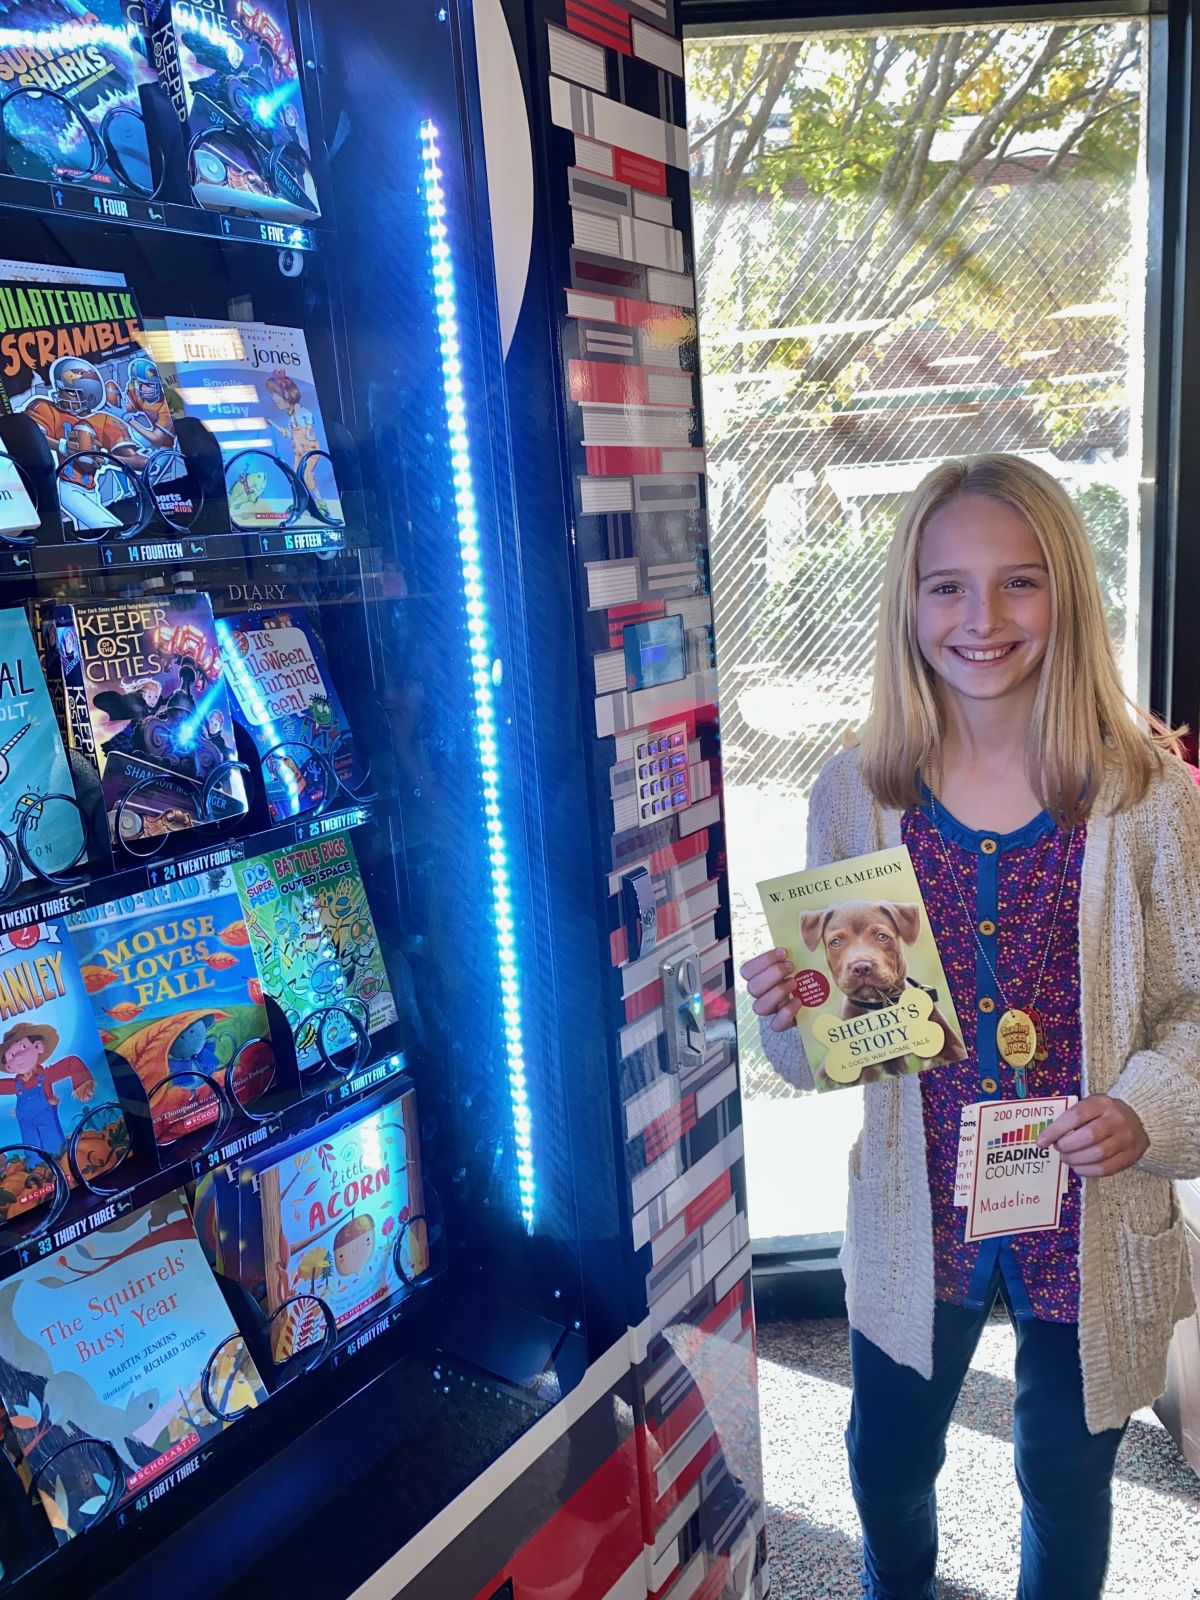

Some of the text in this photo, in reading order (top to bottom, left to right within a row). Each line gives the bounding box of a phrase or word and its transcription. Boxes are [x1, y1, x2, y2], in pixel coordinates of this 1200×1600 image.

[19, 46, 107, 98] SHARKS
[94, 196, 129, 217] 4 FOUR
[260, 225, 286, 243] 5 FIVE
[0, 287, 137, 333] UARTERBACK
[1, 320, 144, 377] SCRAMBLE
[252, 344, 301, 368] jones
[128, 543, 184, 561] 14 FOURTEEN
[284, 533, 323, 549] 15 FIFTEEN
[228, 584, 287, 600] DIARY
[78, 609, 170, 637] KEEPER
[82, 631, 144, 660] LOST
[250, 631, 274, 650] It's
[86, 654, 161, 682] CITIES
[256, 664, 320, 696] Turning
[309, 822, 320, 836] 25
[320, 814, 348, 833] TWENTY
[163, 849, 231, 881] 24 TWENTY FOUR
[242, 862, 269, 887] DC
[273, 838, 347, 879] BATTLE BUGS
[145, 876, 200, 908] READ
[280, 860, 352, 896] OUTER SPACE
[769, 861, 903, 903] W. BRUCE CAMERON
[0, 896, 71, 930] TWENTY THREE
[99, 915, 215, 970] MOUSE
[119, 940, 209, 985] LOVES
[134, 967, 215, 1007] FALL
[848, 1057, 870, 1067] DOG'S
[871, 1053, 886, 1061] WAY
[889, 1045, 911, 1055] HOME
[912, 1038, 930, 1048] TALE
[340, 1064, 387, 1098] 35 THIRTY FIVE
[993, 1106, 1055, 1121] 200 POINTS
[208, 1127, 268, 1168] 34 THIRTY FOUR
[986, 1147, 1050, 1165] READING
[985, 1161, 1044, 1180] COUNTS!
[308, 1163, 390, 1232] ACORN
[980, 1190, 1040, 1213] Madeline
[38, 1204, 117, 1255] 33 THIRTY THREE
[40, 1249, 186, 1347] The Squirrels'
[75, 1292, 179, 1364] Busy Year
[347, 1316, 390, 1356] 45 FORTY FIVE
[102, 1328, 207, 1401] illustrated by RICHARD JONES
[108, 1331, 178, 1380] MARTIN JENKINS
[138, 1434, 198, 1480] SCHOLASTIC
[135, 1456, 200, 1511] 43 FORTY THREE
